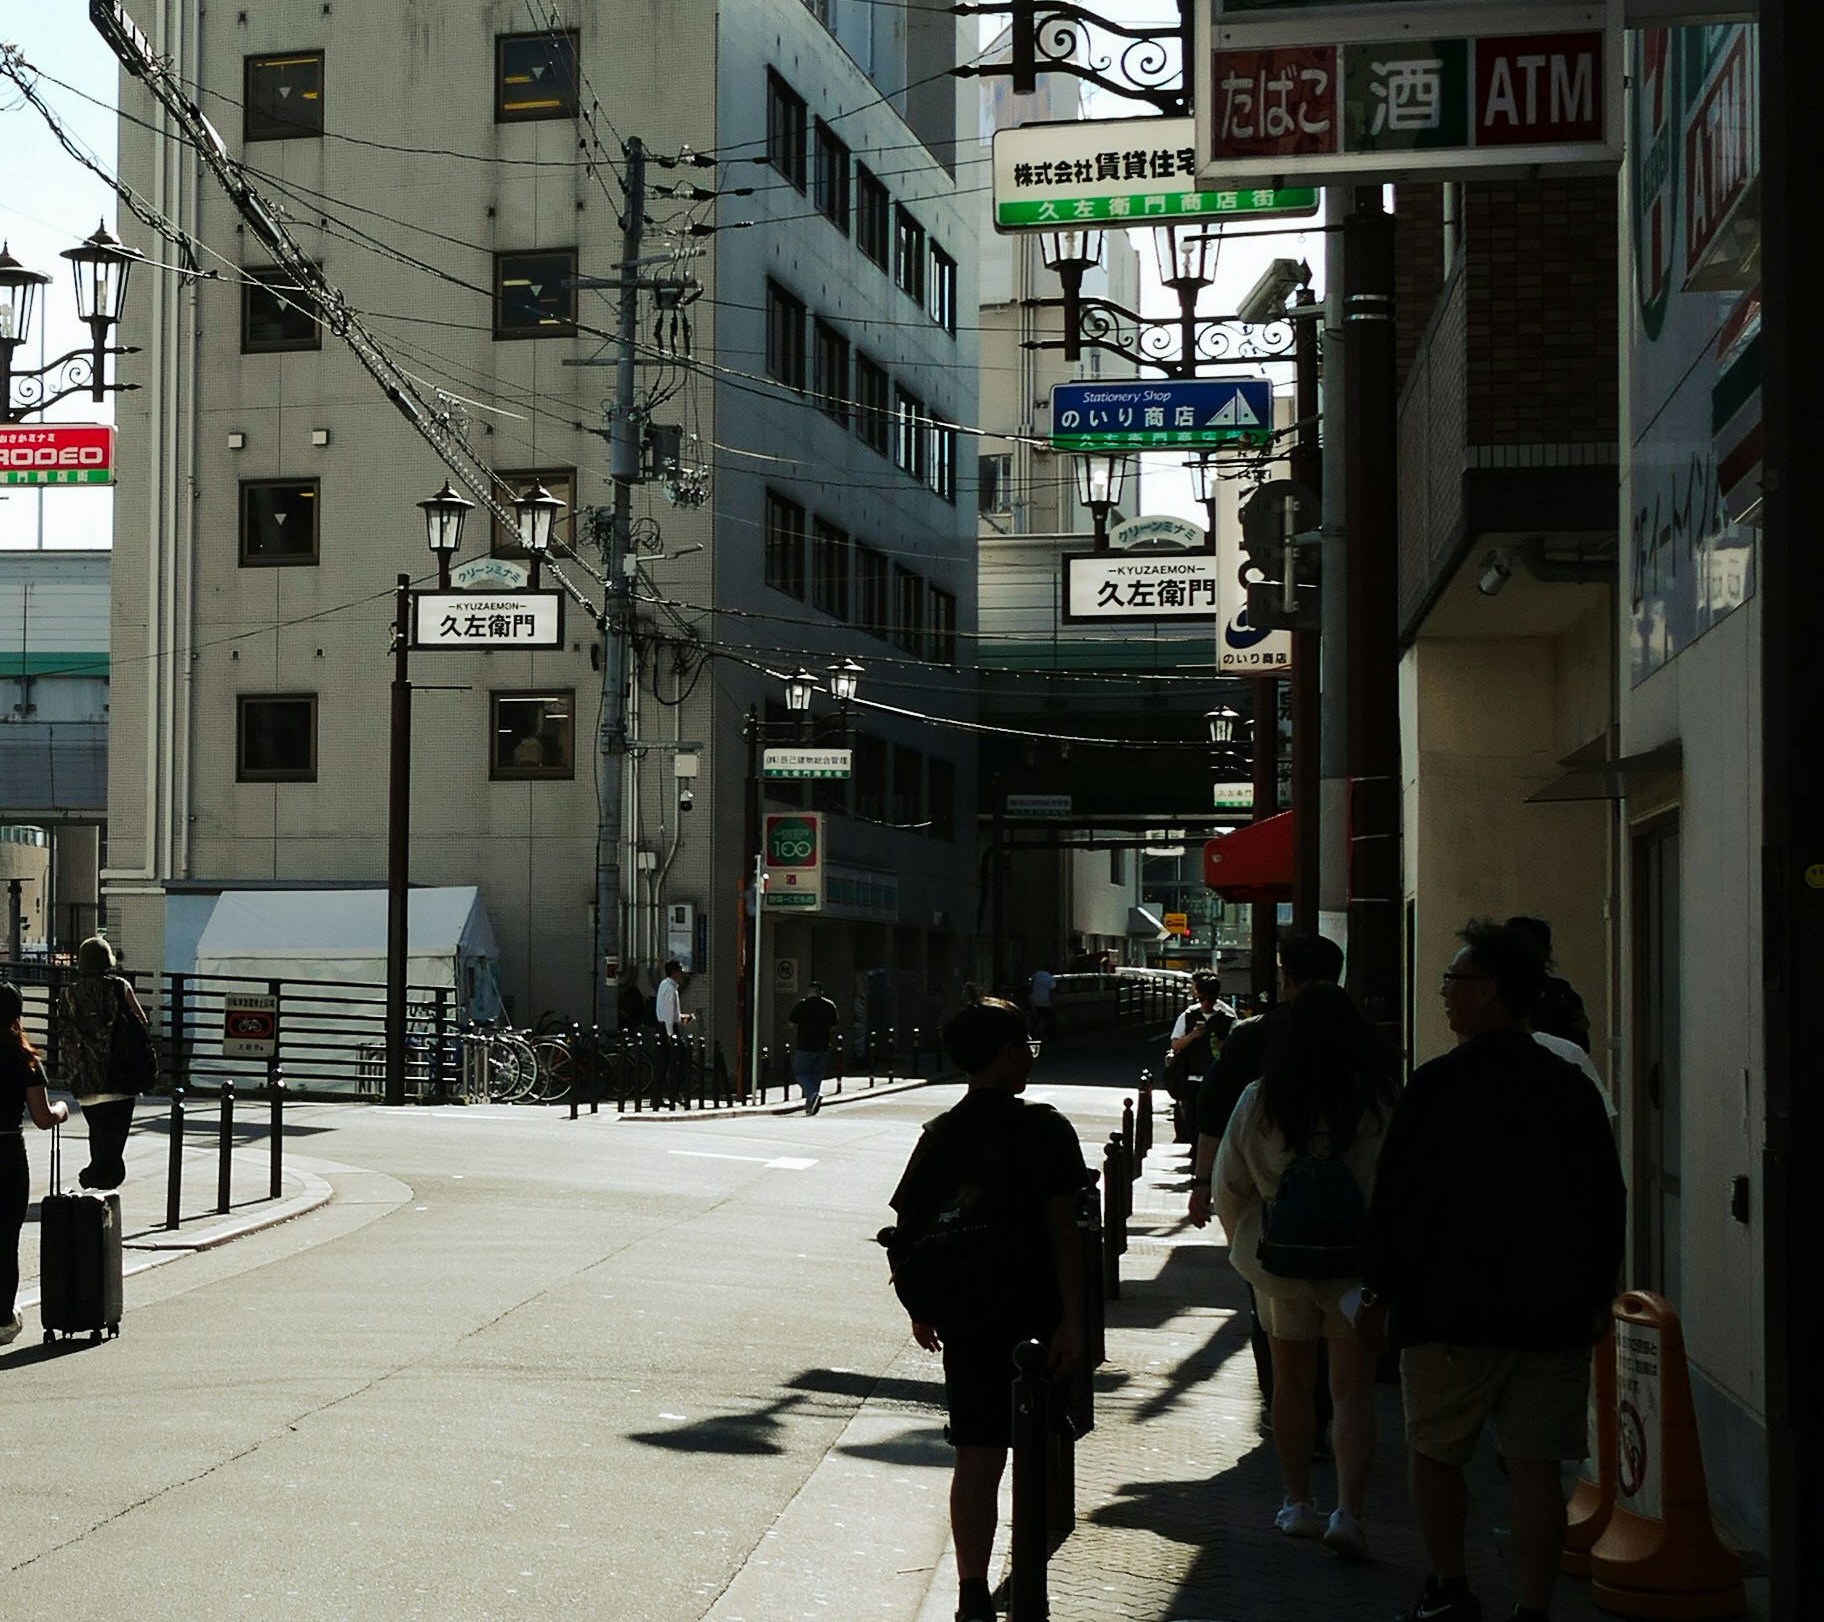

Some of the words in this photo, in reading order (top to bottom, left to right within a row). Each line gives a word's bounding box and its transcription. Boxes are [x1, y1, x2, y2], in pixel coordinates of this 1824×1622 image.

[1221, 63, 1331, 141] たばこ
[1369, 59, 1443, 136] 酒
[1484, 52, 1593, 127] ATM
[1038, 189, 1274, 221] 久左衛門商店街
[1143, 390, 1172, 402] Shop
[1061, 406, 1195, 428] のいり商店
[1119, 520, 1196, 542] クリーンミナミ
[458, 564, 521, 583] クリーンミナミ
[1097, 579, 1216, 608] 久左衛門
[440, 614, 535, 638] 久左衛門
[1223, 652, 1287, 664] のいり商店
